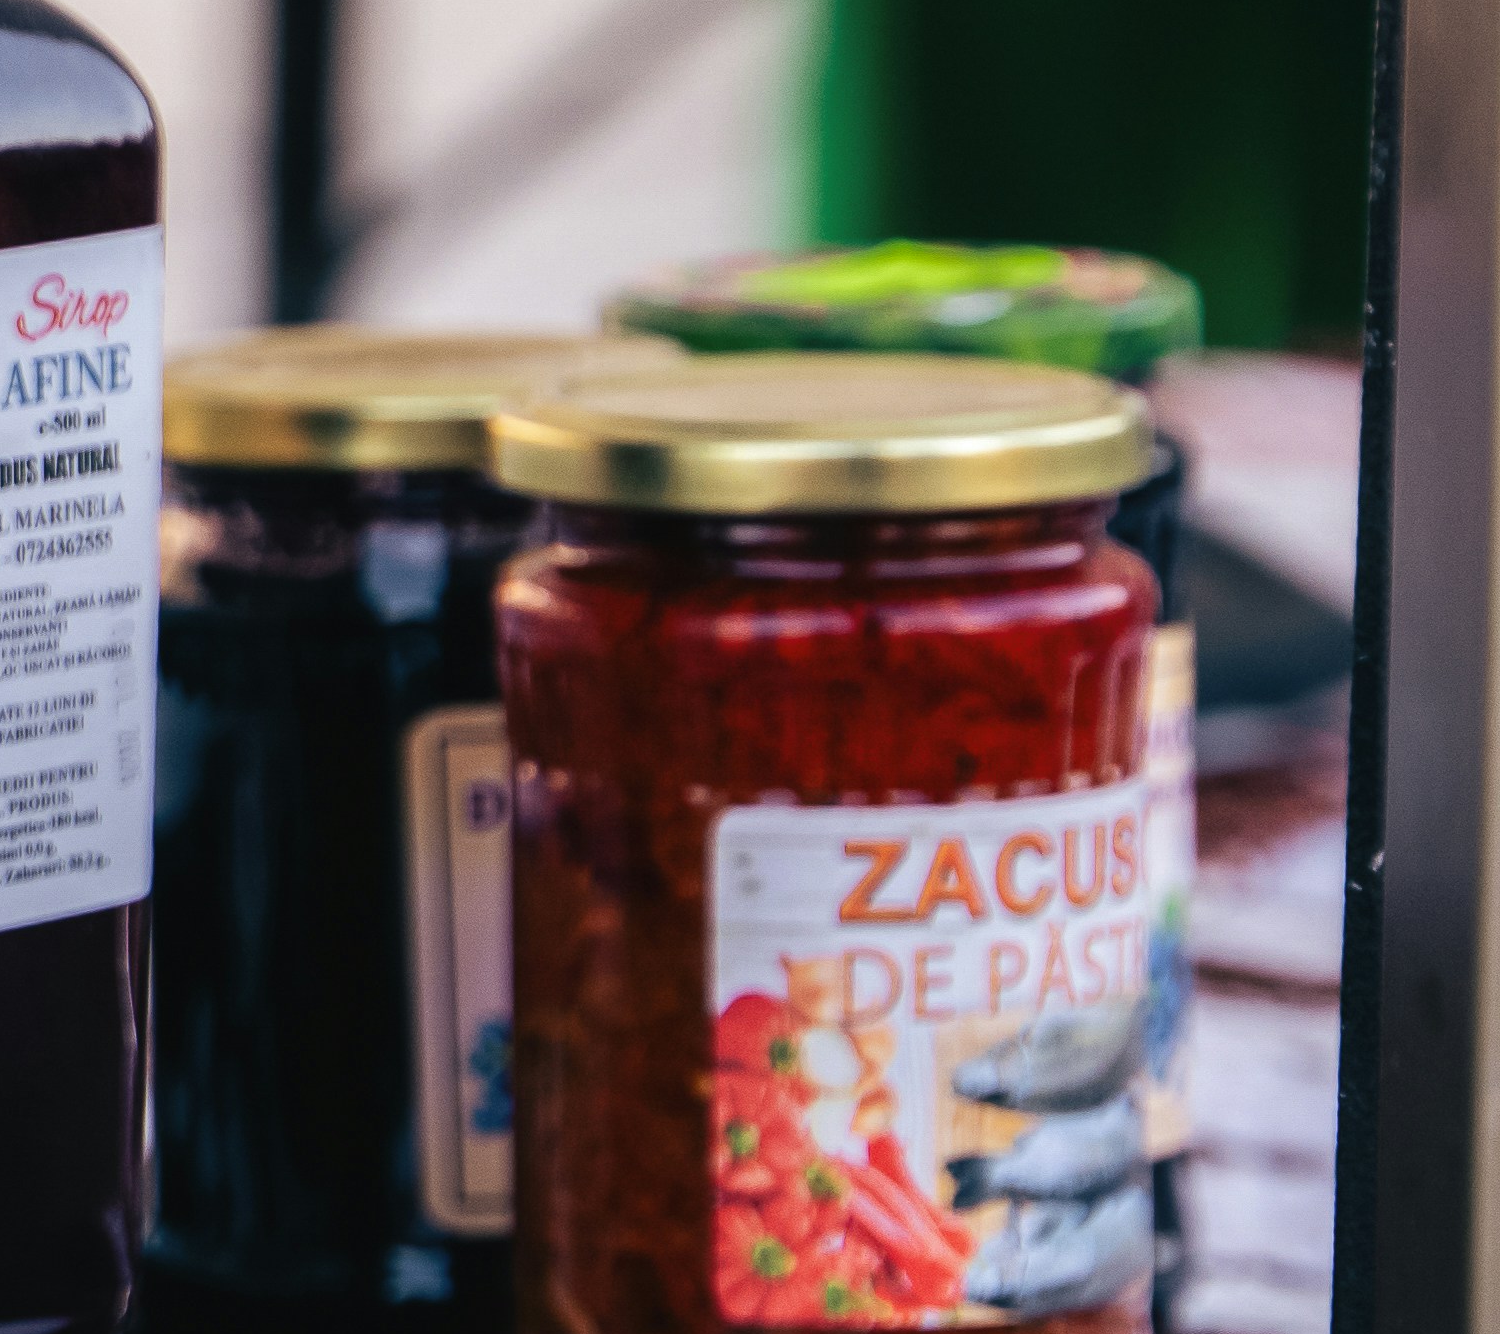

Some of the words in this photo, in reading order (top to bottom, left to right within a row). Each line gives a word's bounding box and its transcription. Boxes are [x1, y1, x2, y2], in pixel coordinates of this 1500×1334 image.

[13, 272, 128, 342] Sirop
[1, 343, 132, 410] AFINE
[838, 814, 1145, 924] ZACUS
[843, 944, 955, 1026] DE
